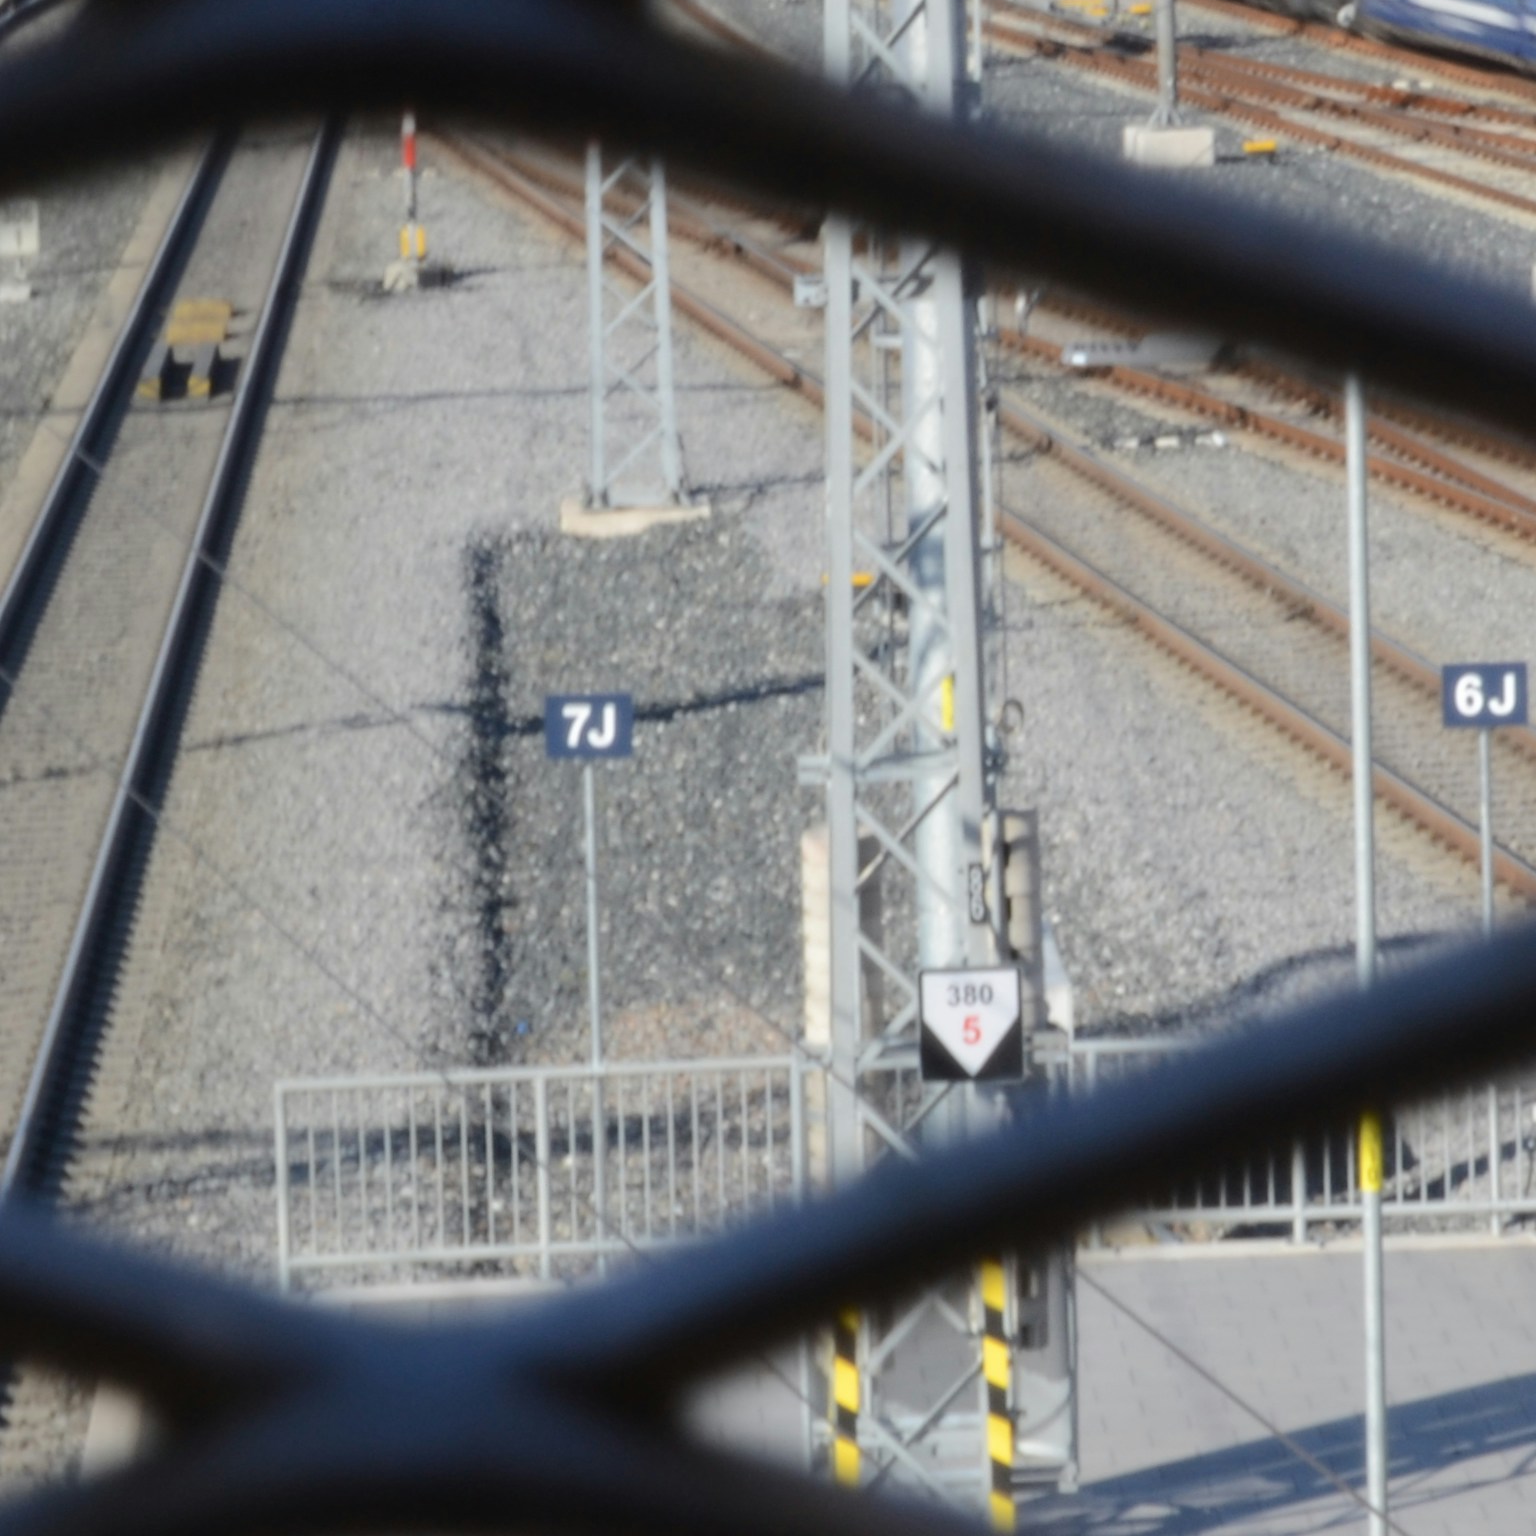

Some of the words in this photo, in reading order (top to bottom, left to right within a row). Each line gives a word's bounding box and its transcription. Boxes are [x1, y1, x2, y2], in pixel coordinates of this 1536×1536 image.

[1454, 672, 1517, 718] 6J
[562, 701, 616, 749] 7J
[946, 983, 994, 1007] 380
[962, 1014, 982, 1045] 5
